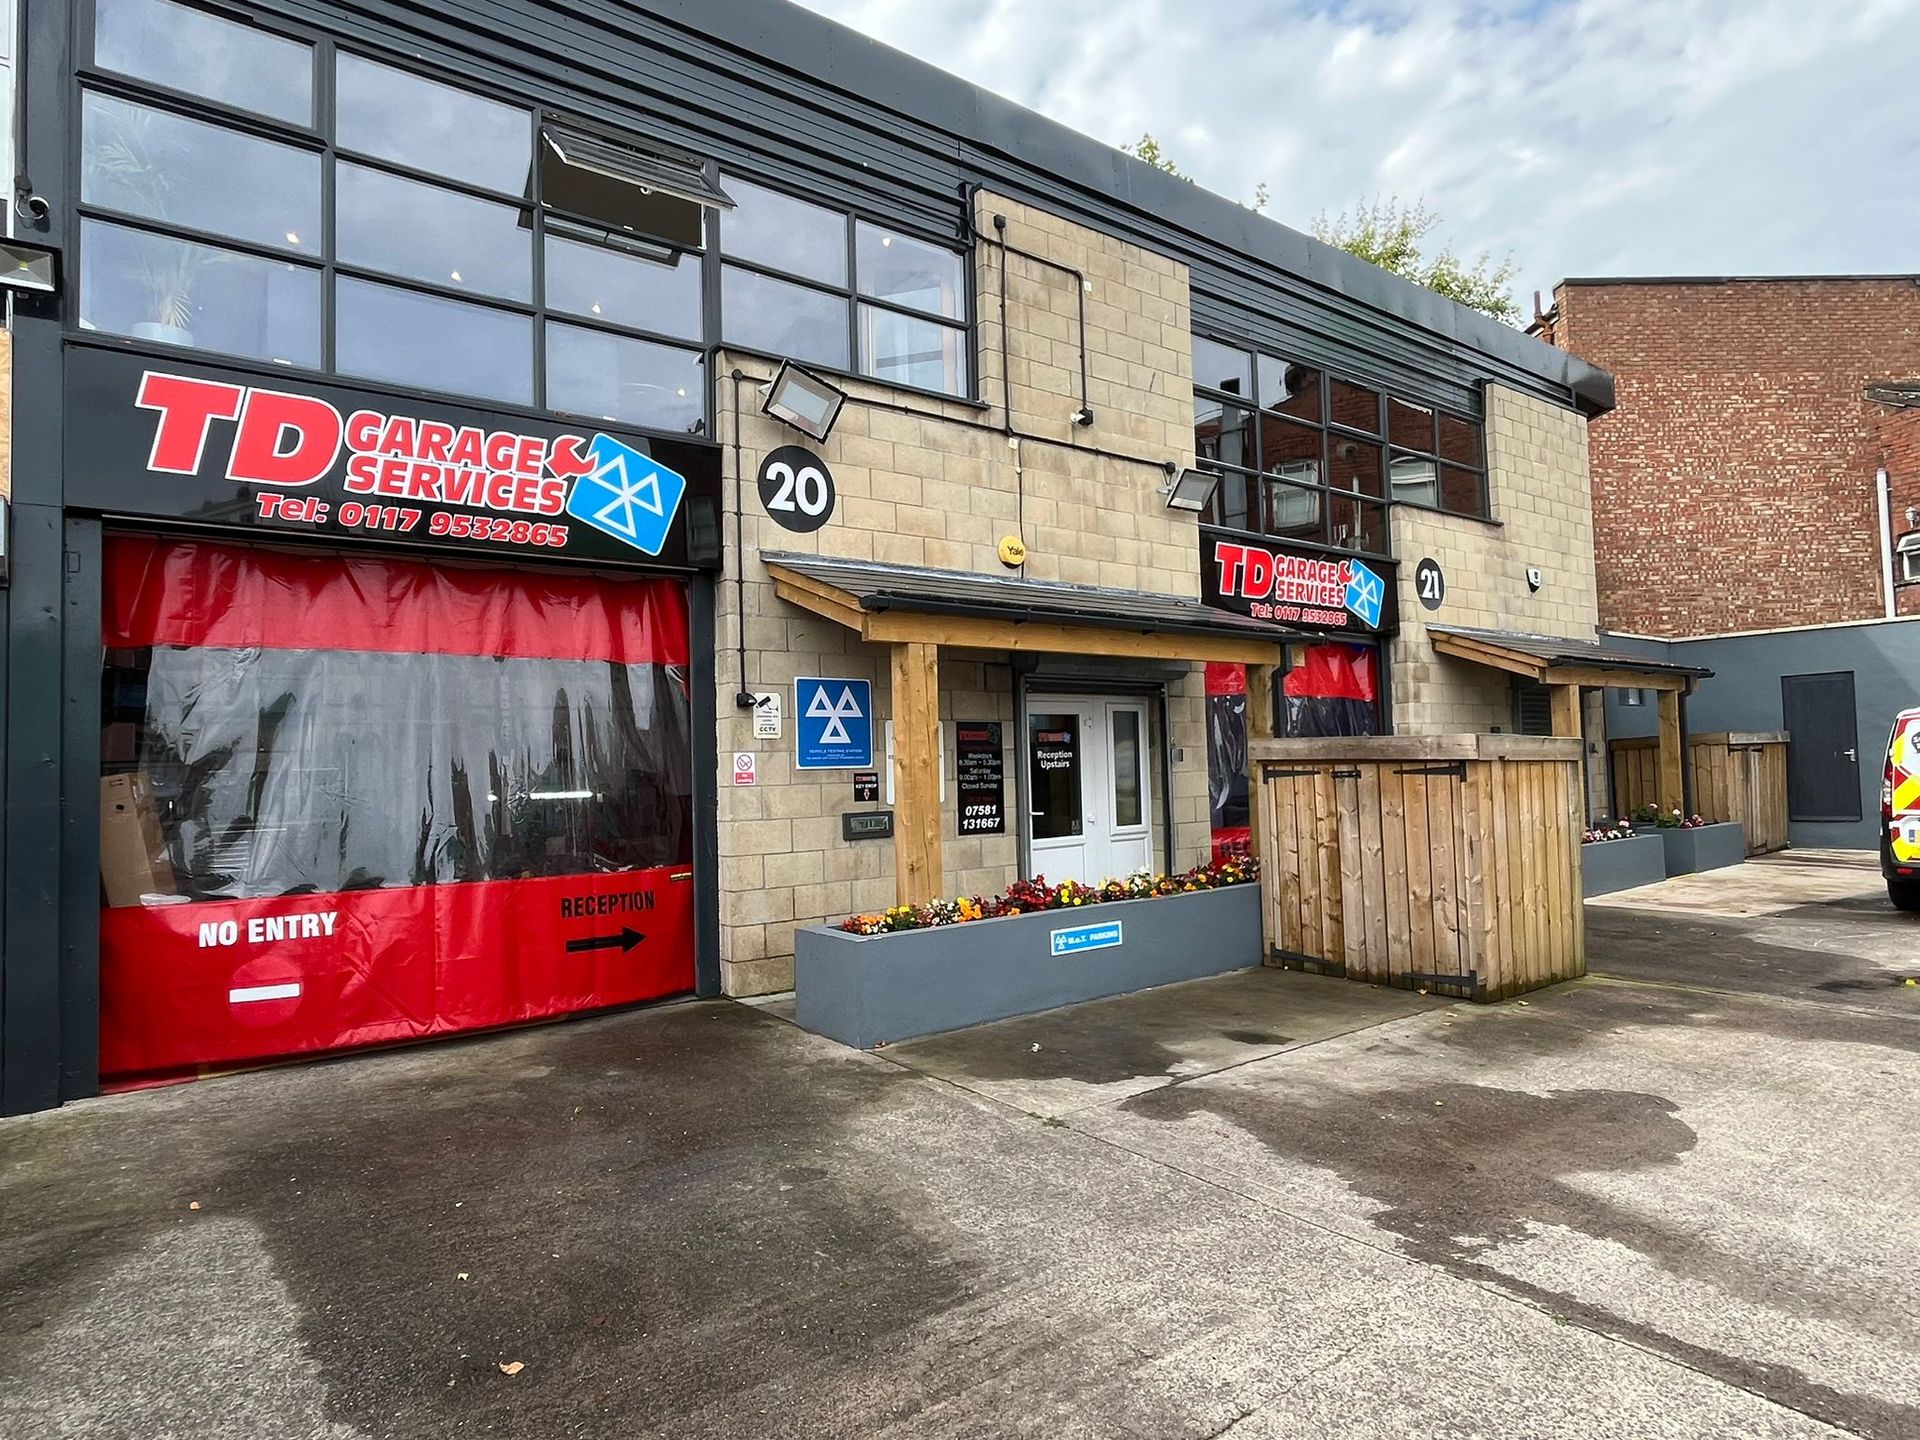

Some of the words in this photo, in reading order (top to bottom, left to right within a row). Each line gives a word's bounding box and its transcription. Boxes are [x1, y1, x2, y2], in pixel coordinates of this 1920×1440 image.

[135, 369, 344, 488] TD
[344, 409, 549, 475] GARAGE
[345, 451, 569, 517] SERVICES
[765, 460, 828, 517] 20
[256, 492, 329, 525] Tel:
[338, 501, 419, 533] 0117
[429, 513, 569, 548] 9532865
[1007, 545, 1024, 556] Yale
[1214, 541, 1273, 600] TD
[1274, 554, 1337, 585] GARAGE
[1420, 567, 1441, 600] 21
[1275, 578, 1345, 608] SERVICES
[1250, 602, 1273, 619] Tel:
[1274, 605, 1300, 621] 0117
[1302, 608, 1347, 626] 9532865
[1037, 750, 1073, 760] Reception
[1040, 760, 1070, 770] Upstairs
[962, 817, 1000, 829] 131667
[965, 805, 997, 816] 07581
[561, 890, 655, 919] RECEPTION
[199, 920, 238, 948] NO
[248, 911, 338, 945] ENTRY
